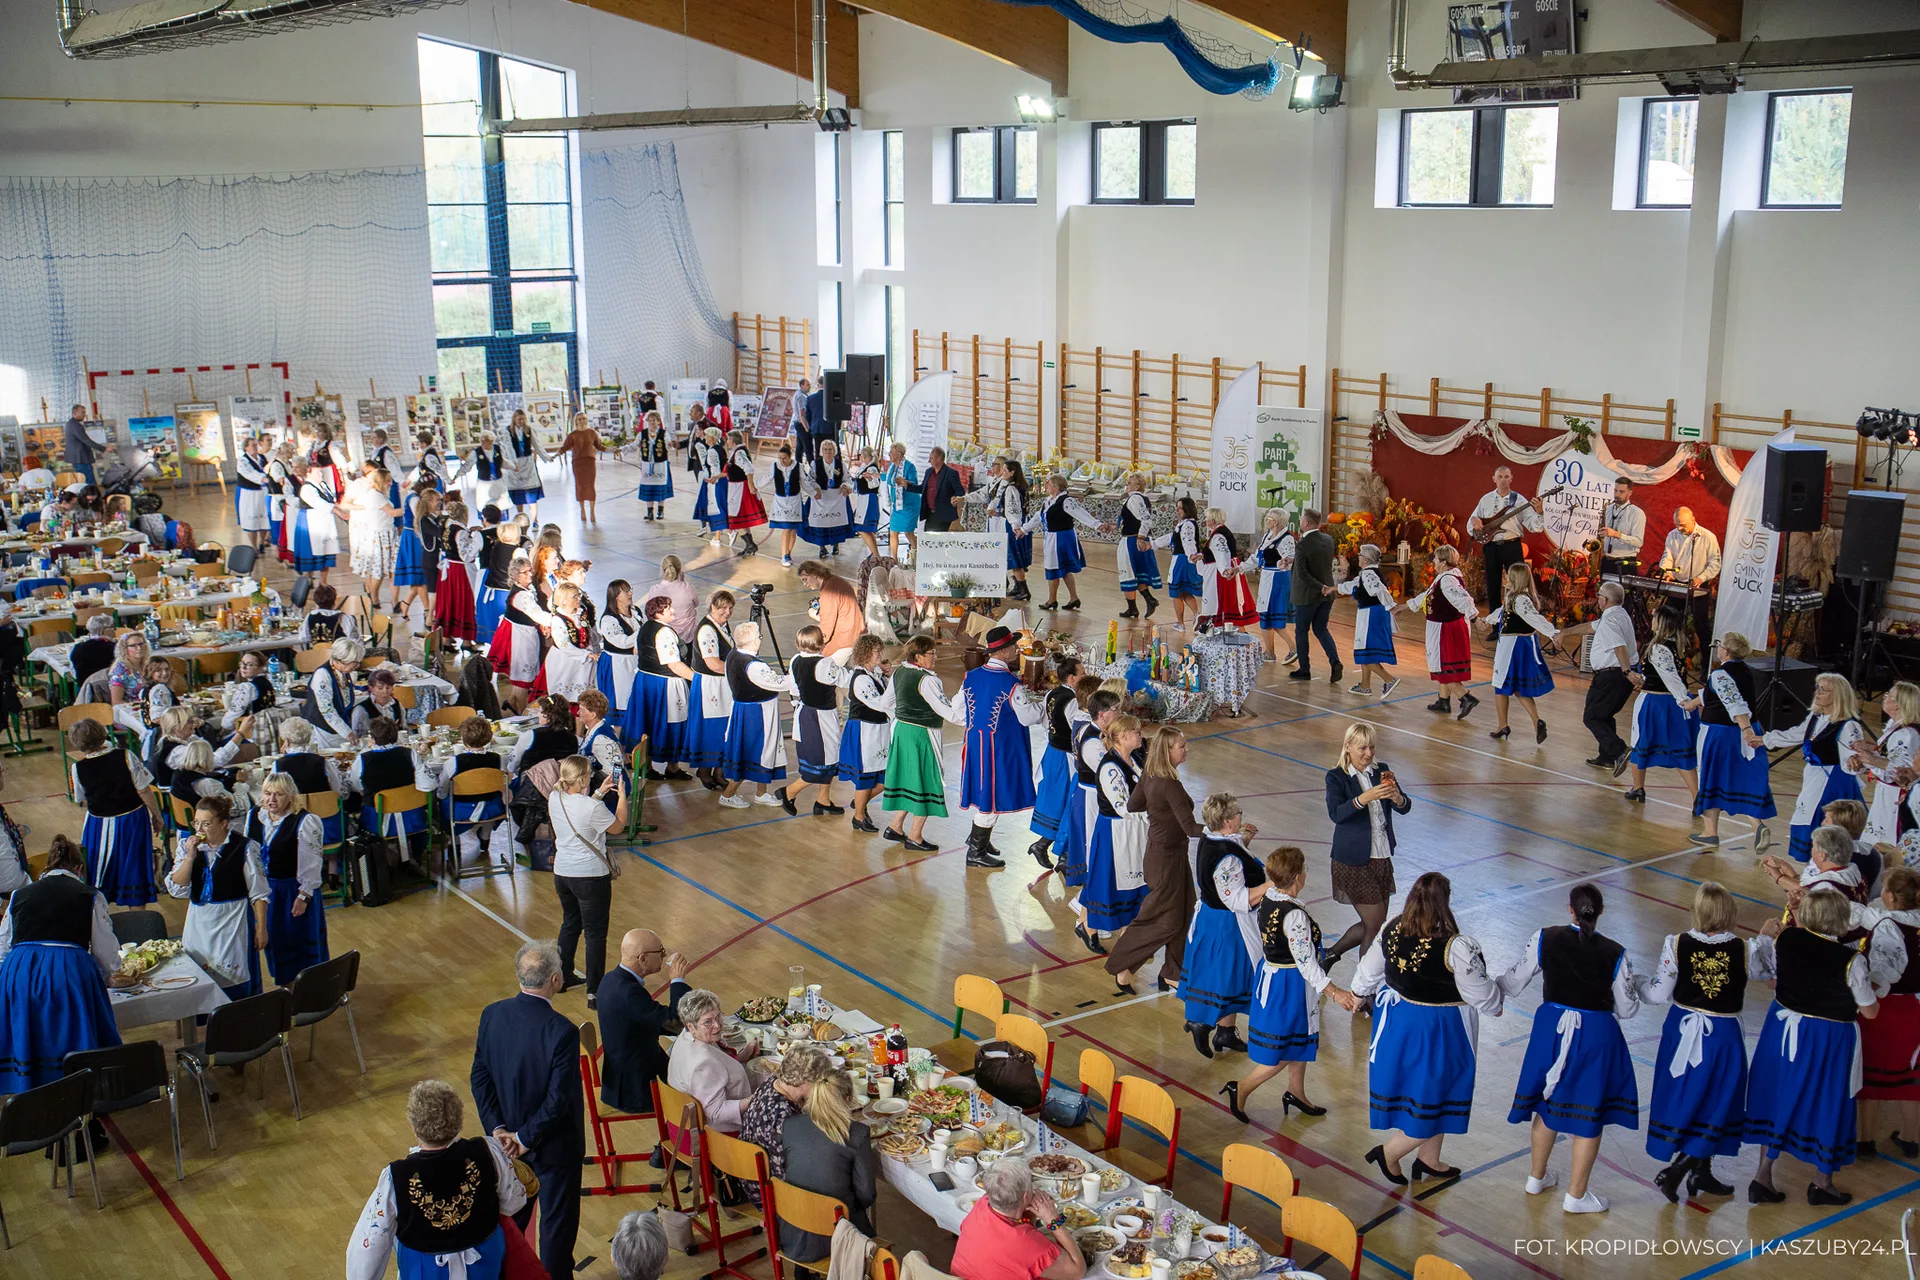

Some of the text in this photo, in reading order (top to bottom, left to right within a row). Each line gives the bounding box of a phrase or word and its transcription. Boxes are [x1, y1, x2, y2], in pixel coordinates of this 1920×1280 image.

[1512, 44, 1526, 56] GRY
[1222, 436, 1249, 469] 35
[1264, 447, 1287, 461] PART
[1219, 470, 1248, 480] GMINY
[1554, 458, 1611, 494] 30 LAT
[1219, 481, 1247, 491] PUCK
[1738, 518, 1769, 564] 35
[1734, 563, 1765, 578] GMINY
[1732, 576, 1763, 594] PUCK
